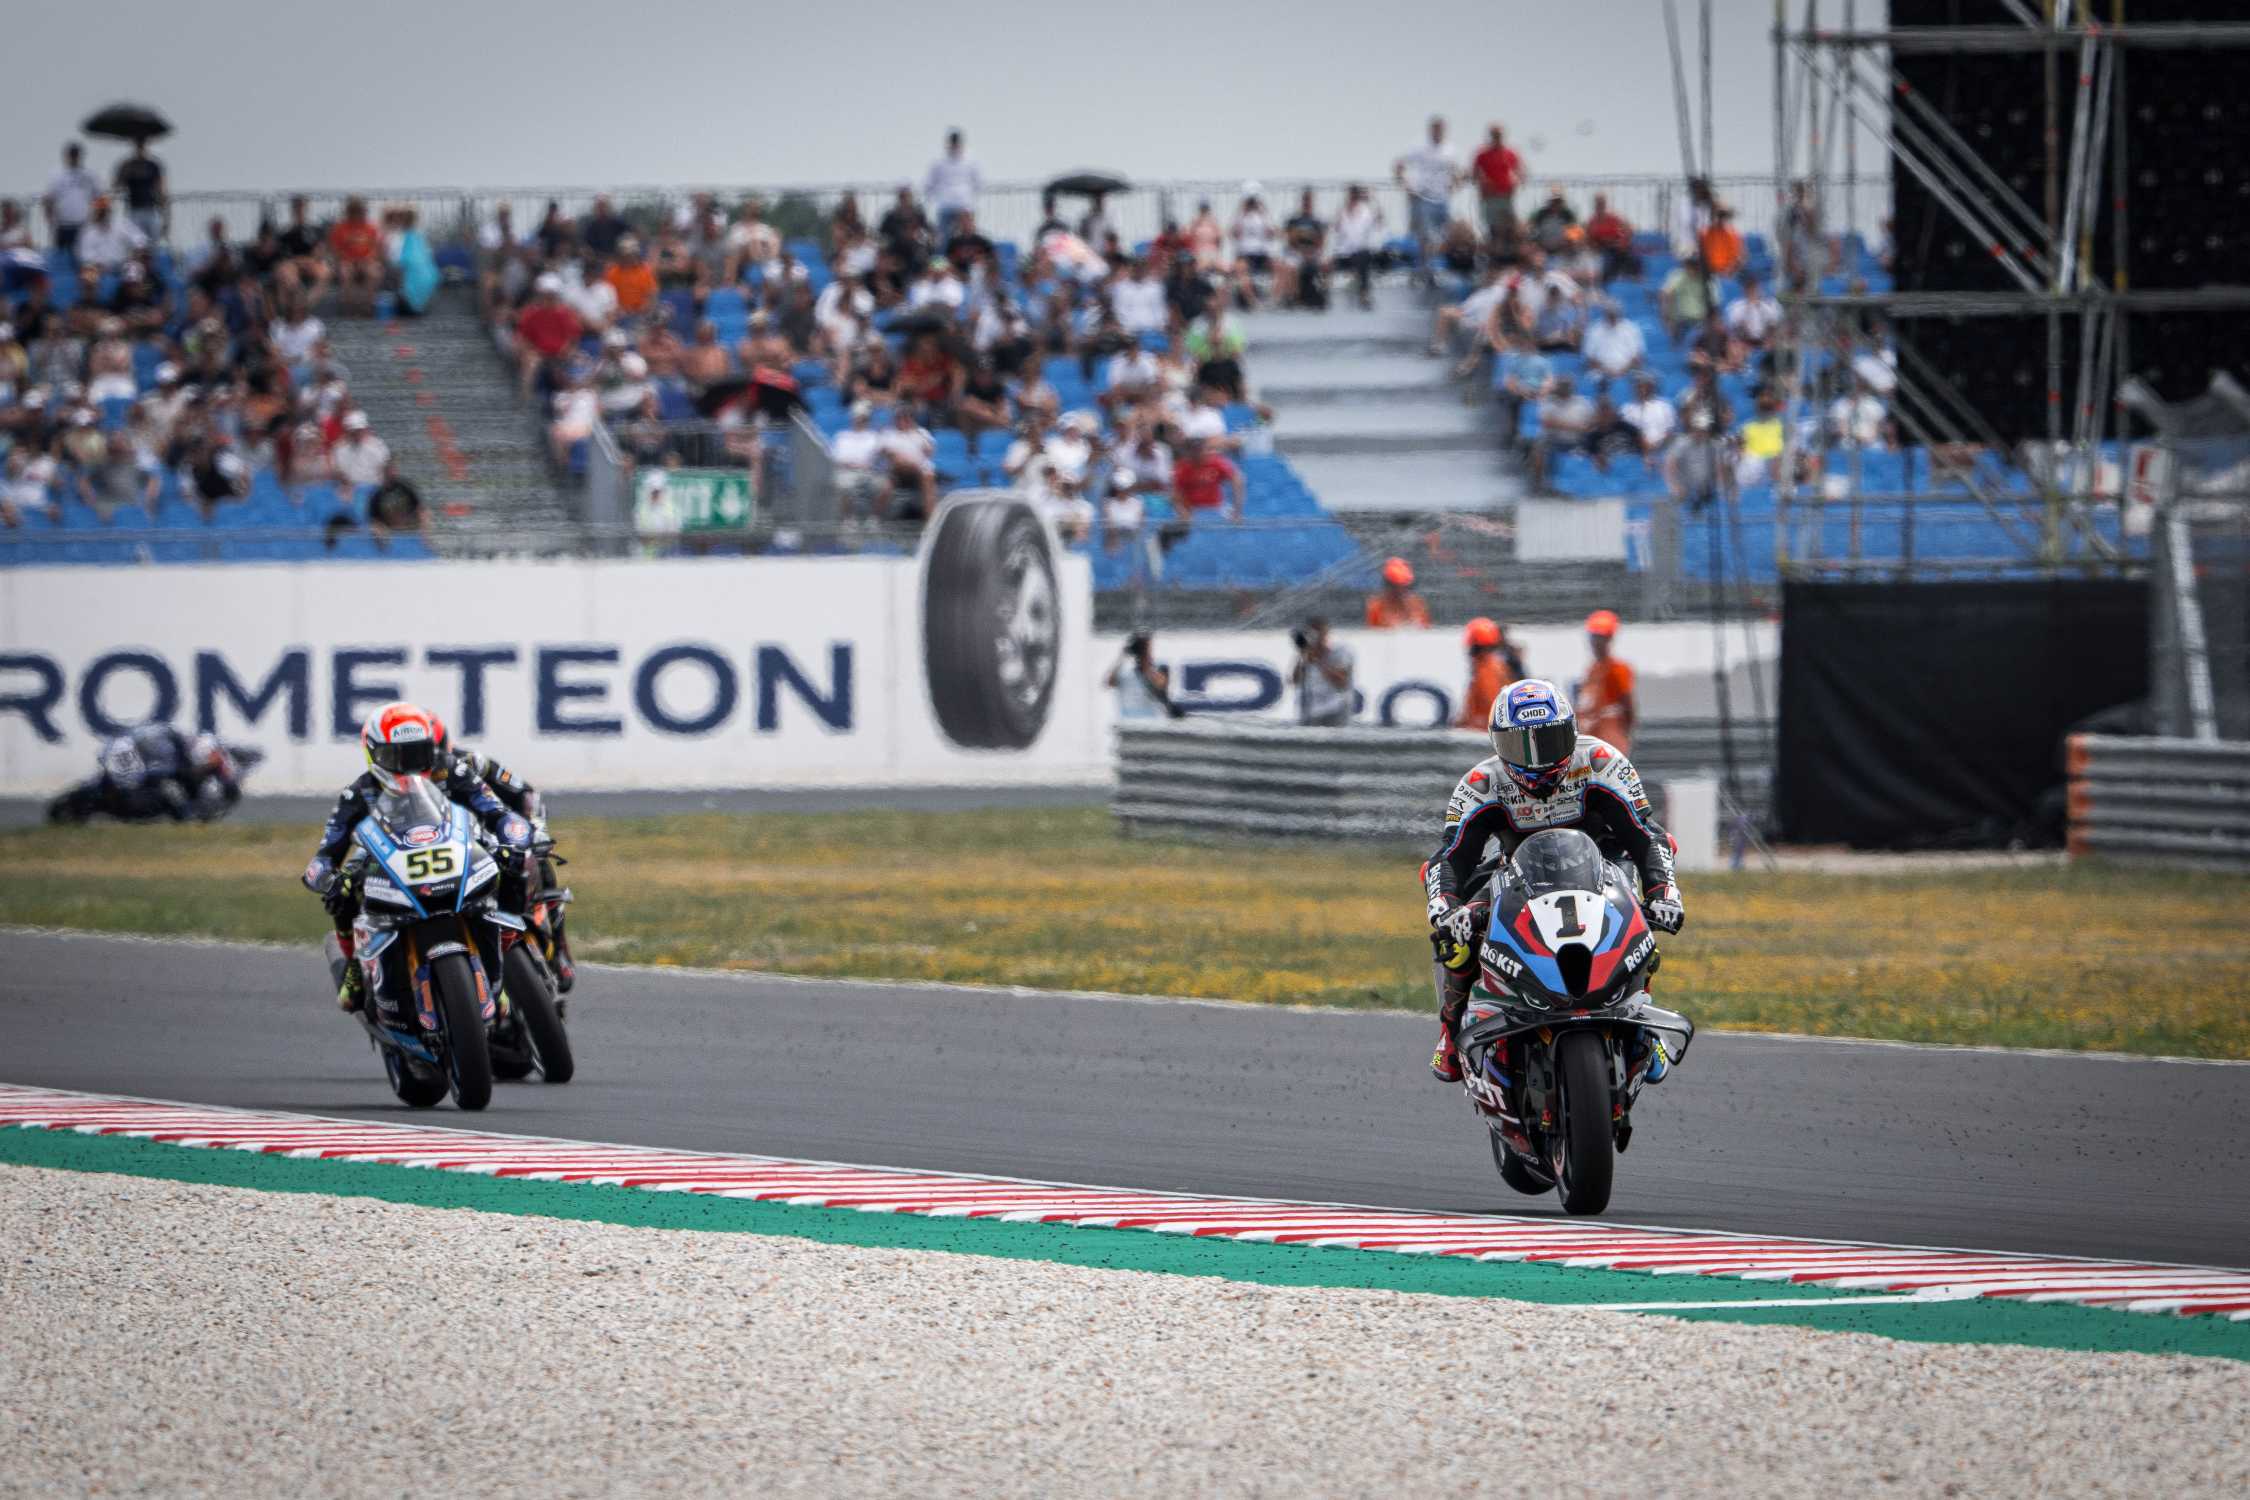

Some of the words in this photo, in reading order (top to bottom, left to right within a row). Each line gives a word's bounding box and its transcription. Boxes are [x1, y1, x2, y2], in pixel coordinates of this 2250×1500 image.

[0, 644, 853, 743] ROMETEON
[1520, 707, 1546, 720] SHOEI
[406, 847, 455, 880] 55
[1554, 895, 1586, 939] 1
